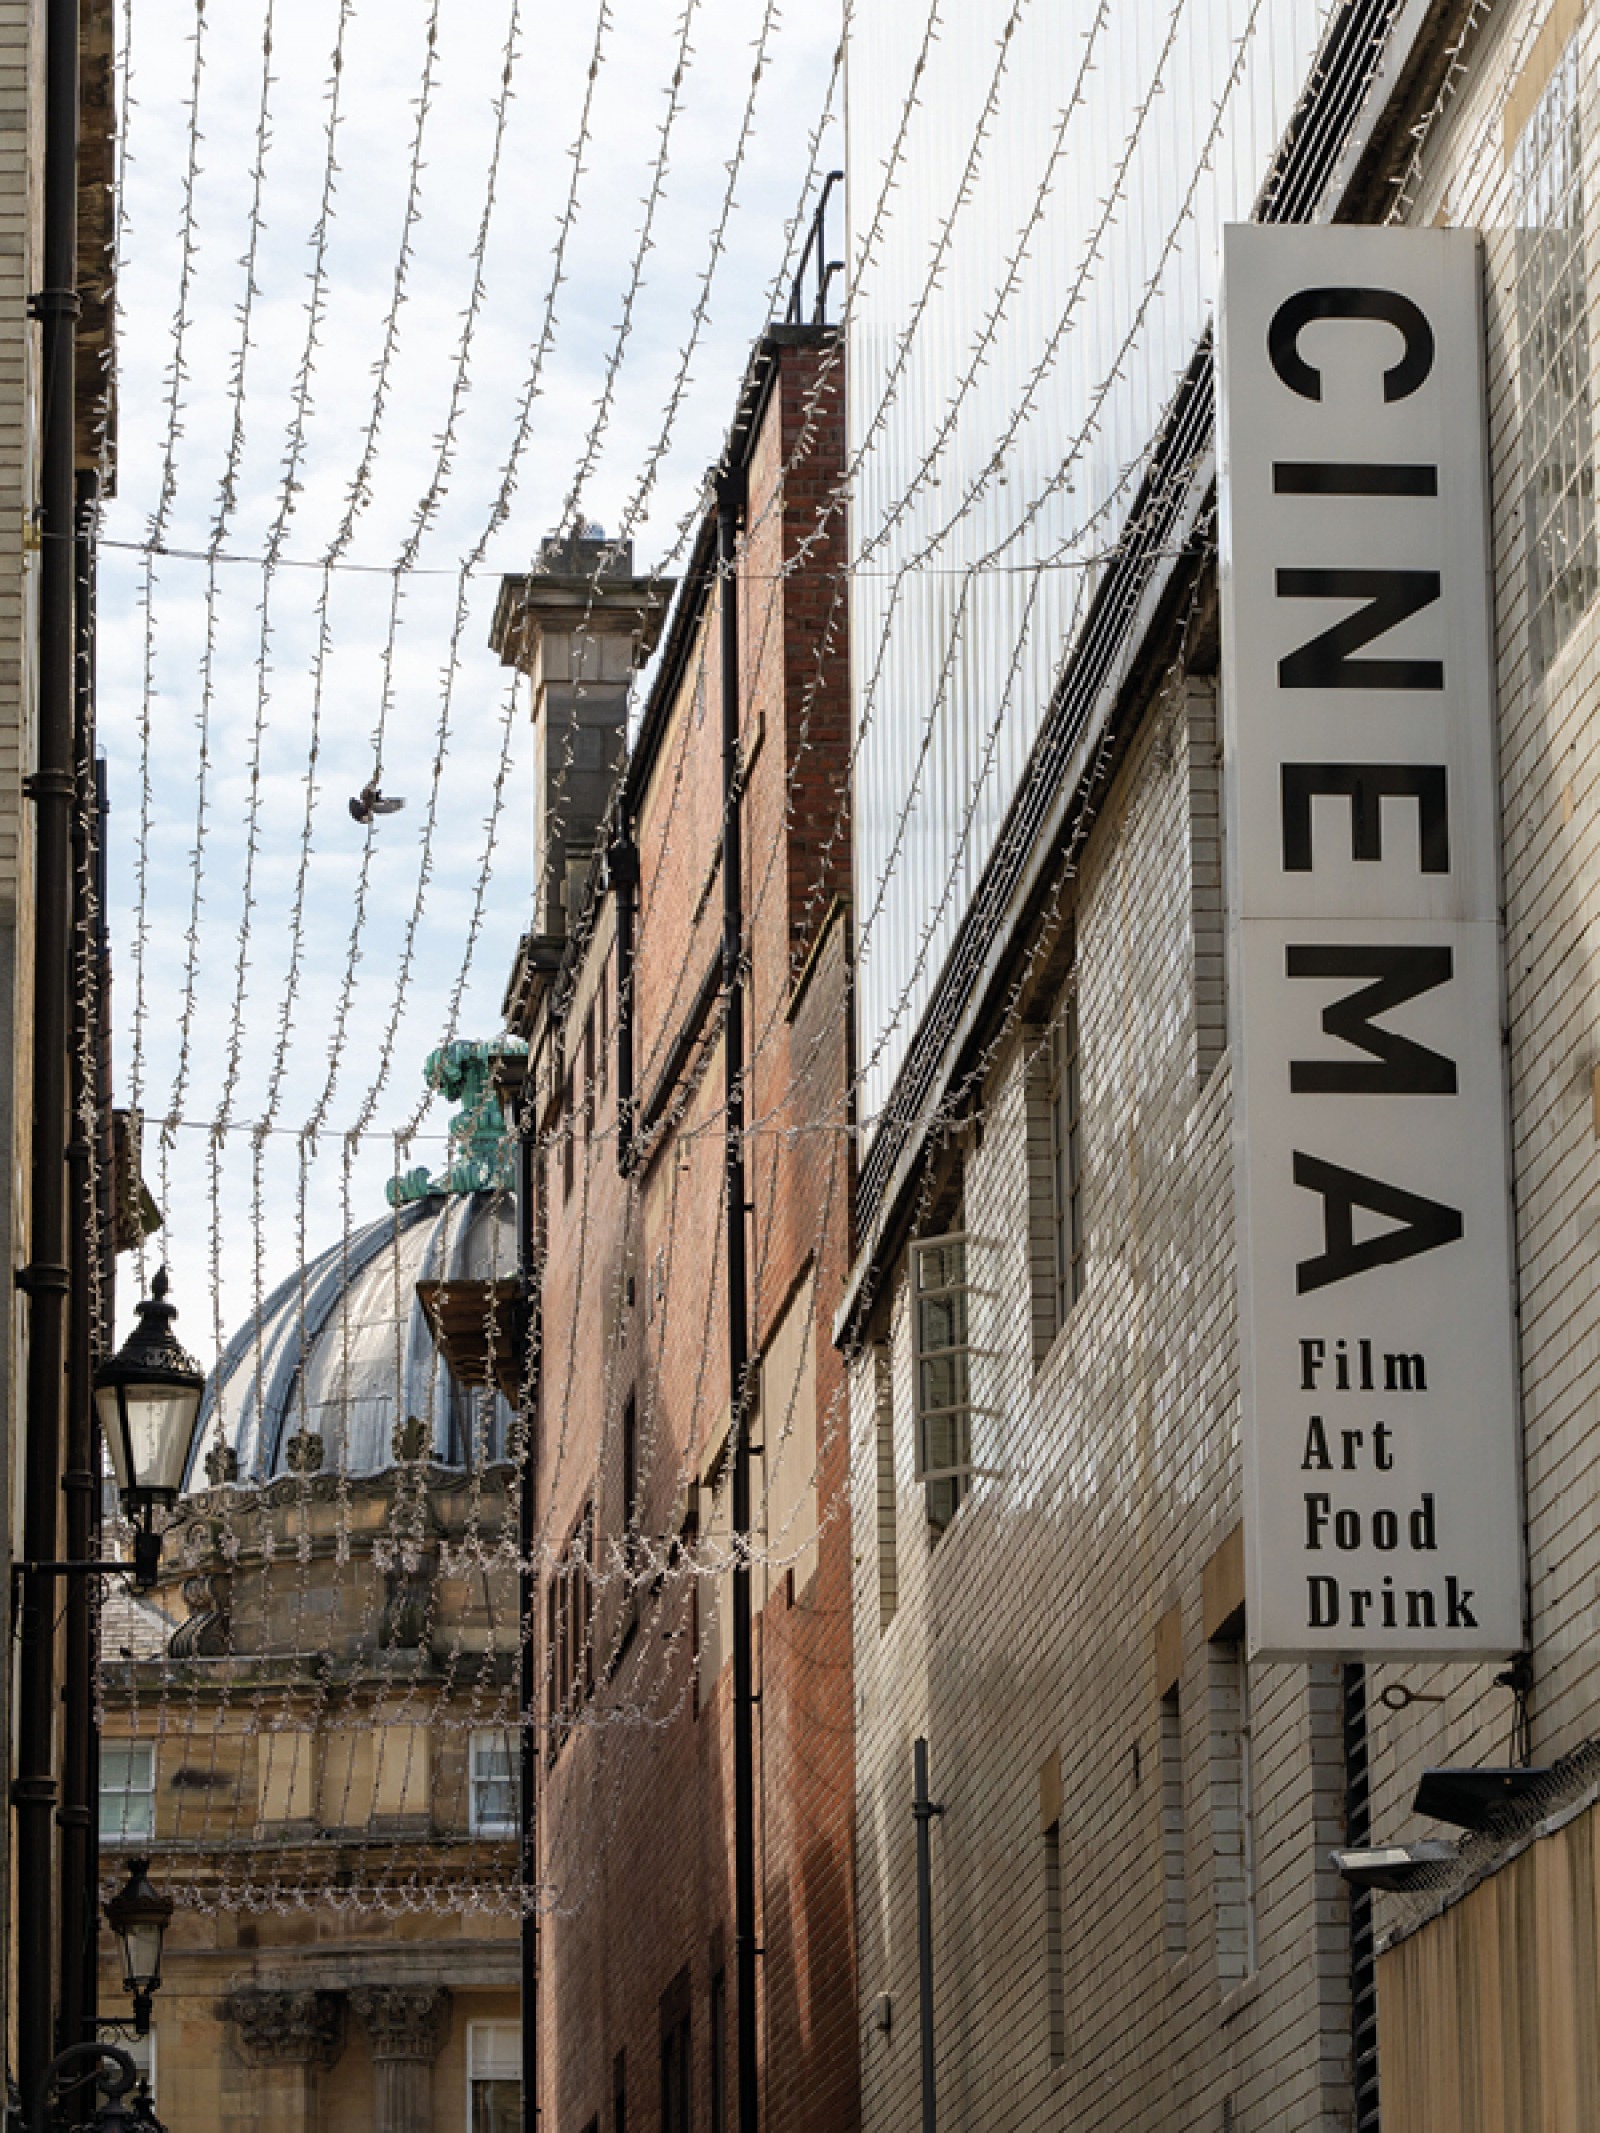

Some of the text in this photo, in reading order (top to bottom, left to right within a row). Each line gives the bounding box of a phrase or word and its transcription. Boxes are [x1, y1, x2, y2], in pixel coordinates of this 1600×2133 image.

[1267, 288, 1464, 1295] CINEMA
[1299, 1339, 1427, 1391] Film
[1301, 1416, 1392, 1471] Art
[1304, 1493, 1437, 1550] Food
[1307, 1576, 1478, 1627] Drink
